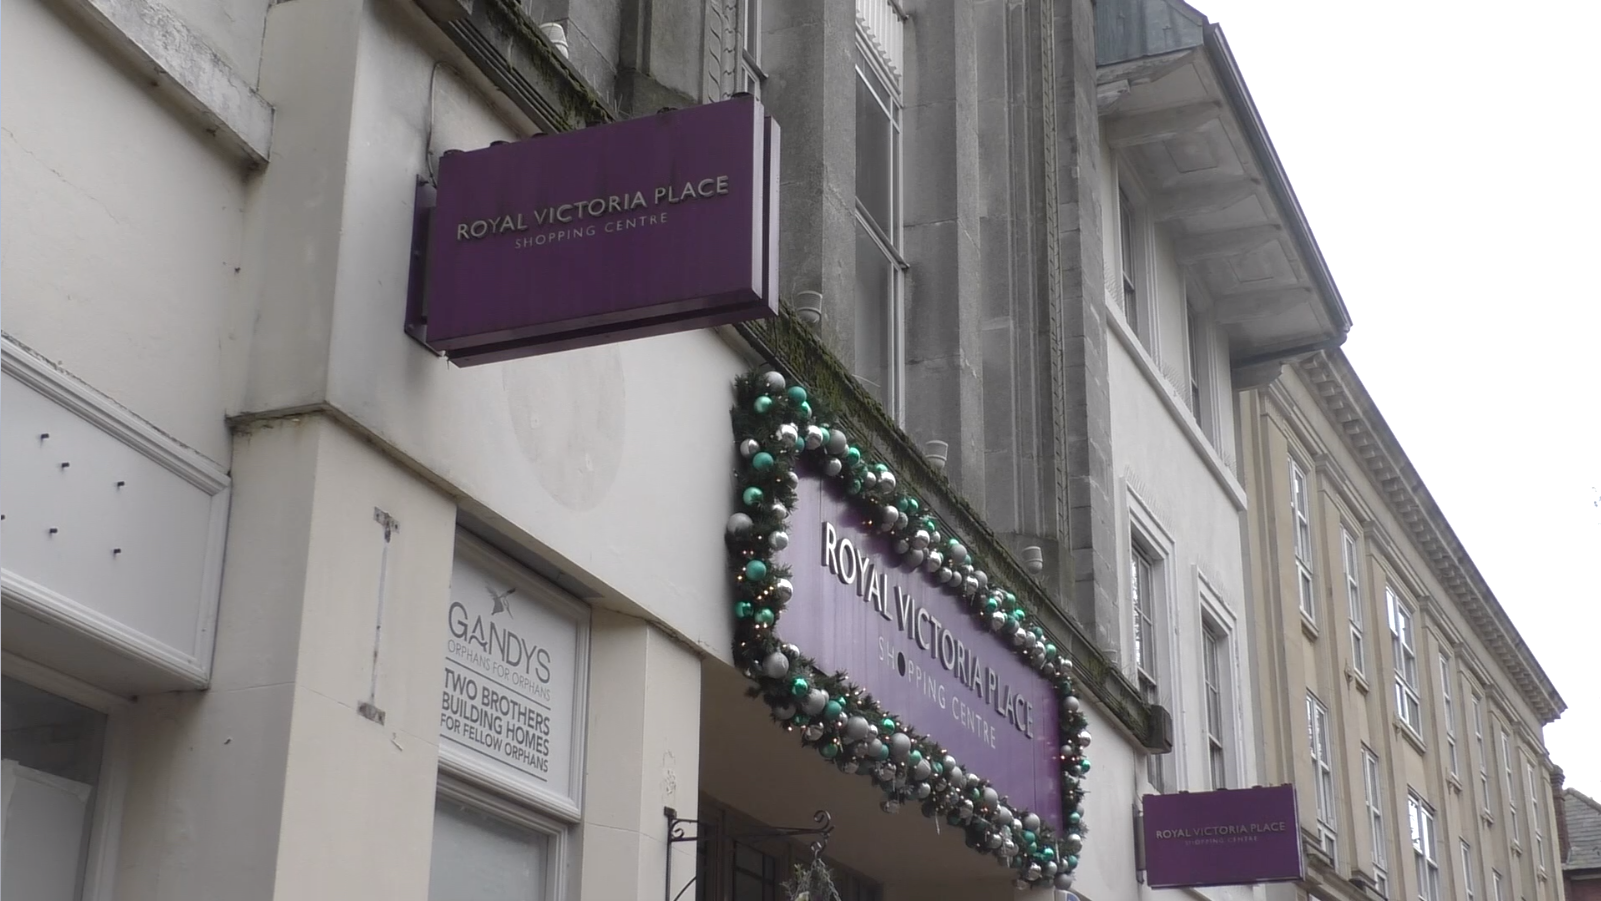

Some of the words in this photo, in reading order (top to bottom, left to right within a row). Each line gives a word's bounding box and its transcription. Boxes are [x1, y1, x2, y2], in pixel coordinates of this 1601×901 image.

[457, 213, 528, 240] ROYAL
[534, 191, 647, 226] VICTORIA
[654, 175, 730, 205] PLACE
[515, 225, 596, 249] SHOPPING
[605, 212, 668, 233] CENTRE
[448, 601, 551, 684] GANDYS
[822, 521, 893, 622] ROYAL
[894, 585, 984, 698] VICTORIA
[985, 667, 1035, 739] PLACE
[445, 667, 478, 701] TWO
[481, 686, 550, 736] BROTHERS
[447, 639, 491, 672] ORPHANS
[493, 663, 510, 681] FOR
[512, 672, 551, 702] ORPHANS
[440, 713, 461, 735] FOR
[463, 724, 503, 752] FELLOW
[504, 742, 549, 773] ORPHANS
[442, 691, 503, 735] BUILDING
[505, 721, 550, 757] HOMES
[952, 696, 997, 749] CENTRE
[1156, 829, 1191, 839] ROYAL
[1193, 825, 1248, 836] VICTORIA
[1250, 822, 1286, 833] PLACE
